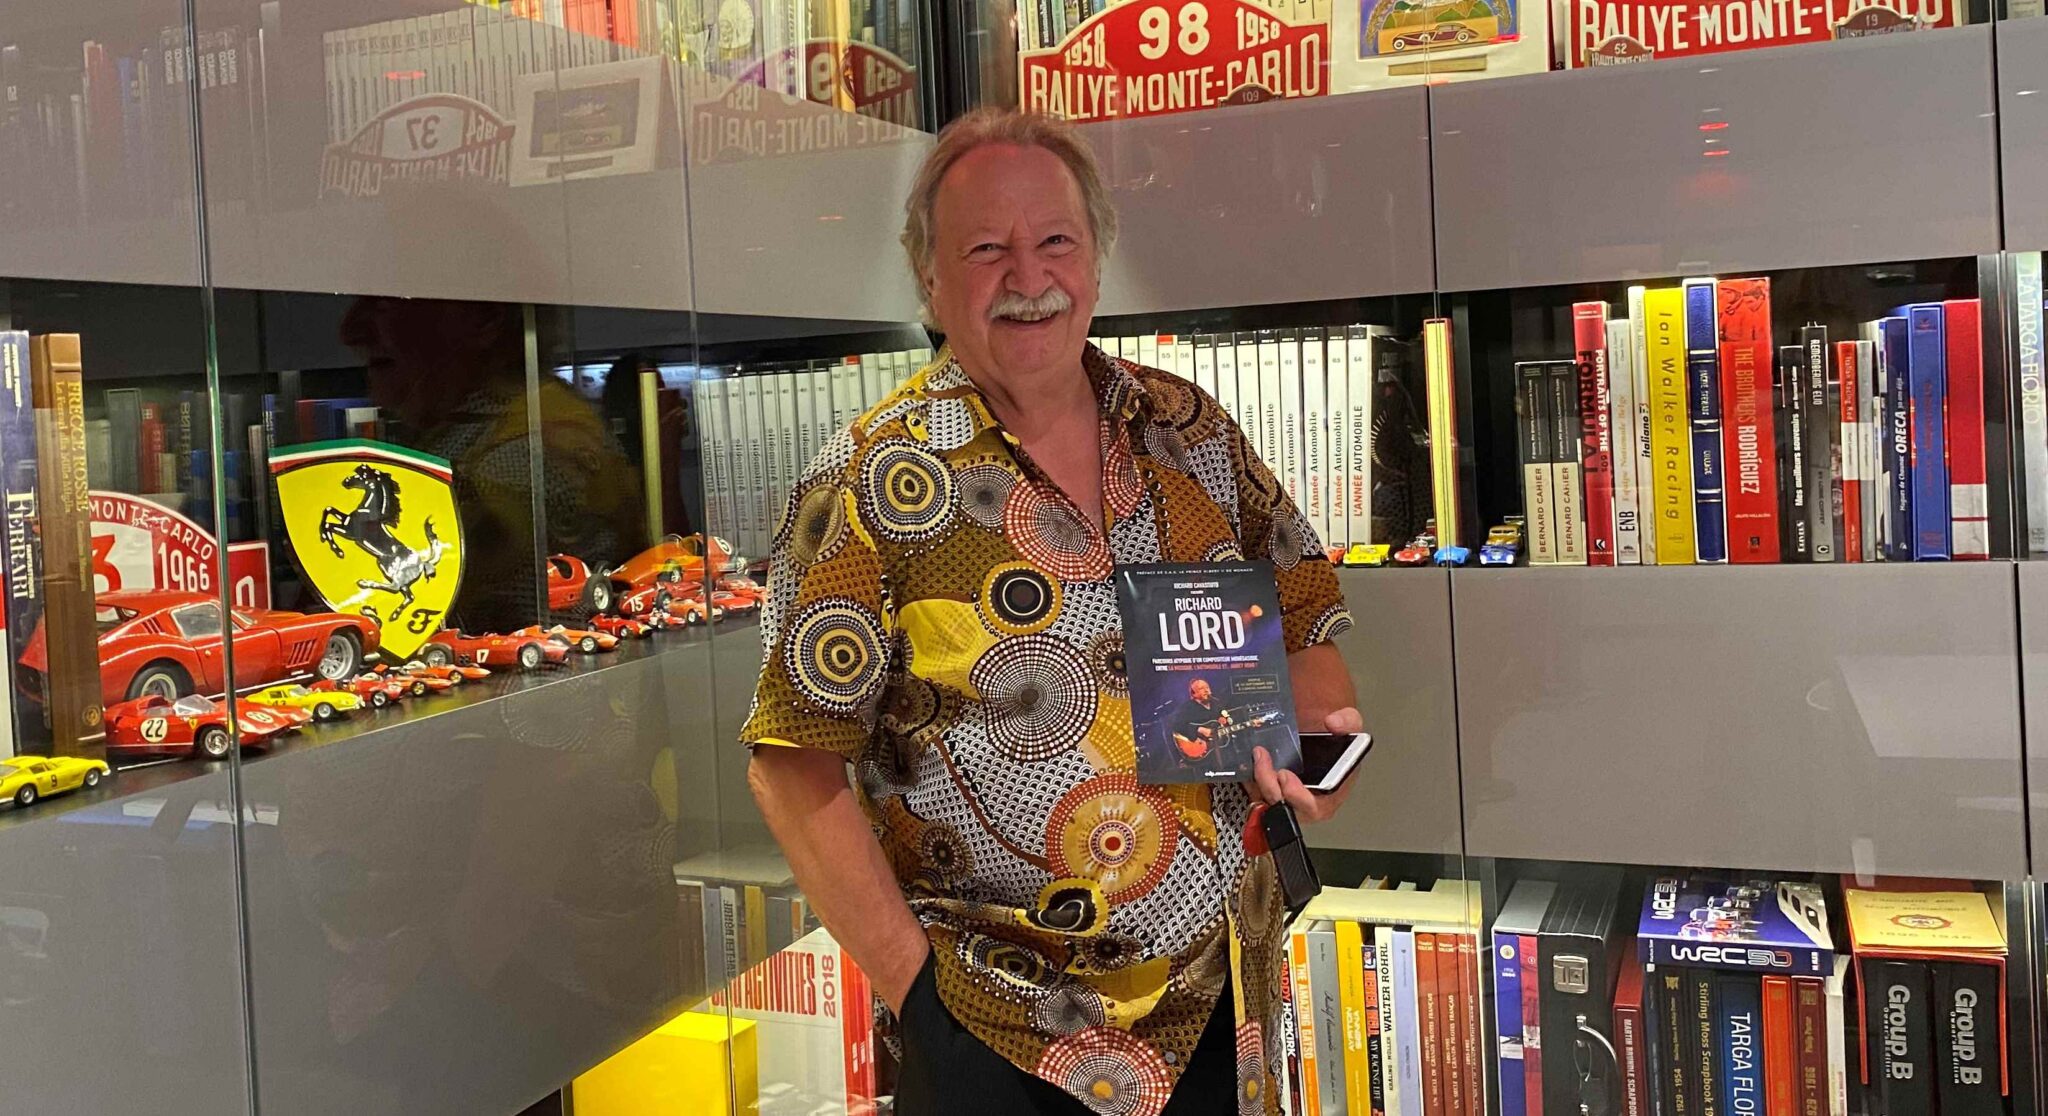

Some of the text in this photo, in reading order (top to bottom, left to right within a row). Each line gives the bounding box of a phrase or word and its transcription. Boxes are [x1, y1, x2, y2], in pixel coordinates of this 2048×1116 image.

[1138, 2, 1210, 60] 98
[1235, 7, 1280, 51] 1958
[1580, 0, 1944, 65] RALLYE MONTE-O
[1865, 14, 1878, 26] 19
[1065, 23, 1105, 68] 1958
[1614, 42, 1627, 54] 52
[1030, 32, 1320, 121] RALLYE MONTE-CARLO
[1242, 90, 1259, 103] 109
[2018, 294, 2039, 360] TARGA
[1595, 349, 1606, 411] PORTRAITS
[1735, 347, 1754, 368] THE
[1810, 339, 1823, 406] REMEMBERING ELIO
[1578, 350, 1598, 460] FORMULA
[1659, 312, 1679, 520] Ian Walker Racing
[1735, 369, 1757, 423] BROTHERS
[2021, 362, 2040, 424] FLORIO
[1269, 403, 1277, 464] Automobile
[1288, 412, 1296, 474] Automobile
[1335, 410, 1343, 472] Automobile
[1598, 414, 1608, 428] OF
[1598, 431, 1609, 452] THE
[1641, 415, 1650, 458] italiano
[1790, 413, 1801, 451] souvenirs
[1895, 410, 1908, 454] ORECA
[67, 381, 89, 512] FRECCE ROSSE
[1311, 411, 1320, 518] L'Année Automobile
[1353, 405, 1363, 517] L'ANNÉE AUTOMOBILE
[1738, 425, 1762, 494] RODRÍGUEZ
[1535, 467, 1547, 553] BERNARD CAHIER
[1562, 467, 1574, 553] BERNARD CAHIER
[1794, 489, 1804, 506] Mes
[6, 486, 35, 599] FERRARI
[89, 500, 213, 561] MONTE-CARLO
[1619, 511, 1635, 532] ENB
[157, 541, 210, 593] 1966
[629, 598, 644, 612] 15
[1174, 597, 1222, 612] RICHARD
[1158, 610, 1245, 652] LORD
[476, 649, 489, 663] 17
[146, 718, 164, 739] 22
[51, 775, 58, 788] 9
[822, 954, 836, 1018] 2018
[1380, 943, 1391, 983] RÖHRL
[1295, 963, 1314, 1060] THE AMAZING GATSO
[1382, 986, 1393, 1032] WALTER
[1698, 982, 1709, 1019] Stirling
[1283, 1002, 1297, 1058] HOPKIRK
[1369, 1040, 1379, 1052] MY
[1623, 1018, 1633, 1045] MARTIN
[1700, 1021, 1711, 1048] Moss
[1730, 1012, 1753, 1071] TARGA
[1887, 984, 1914, 1080] Group B
[1954, 988, 1982, 1085] Group B
[1371, 1054, 1381, 1085] RACING
[1373, 1085, 1381, 1100] LIFE
[1673, 1068, 1682, 1087] 1954
[1700, 1050, 1714, 1103] Scrapbook
[1627, 1078, 1638, 1116] SCRAPBOO
[1806, 1098, 1817, 1116] 929
